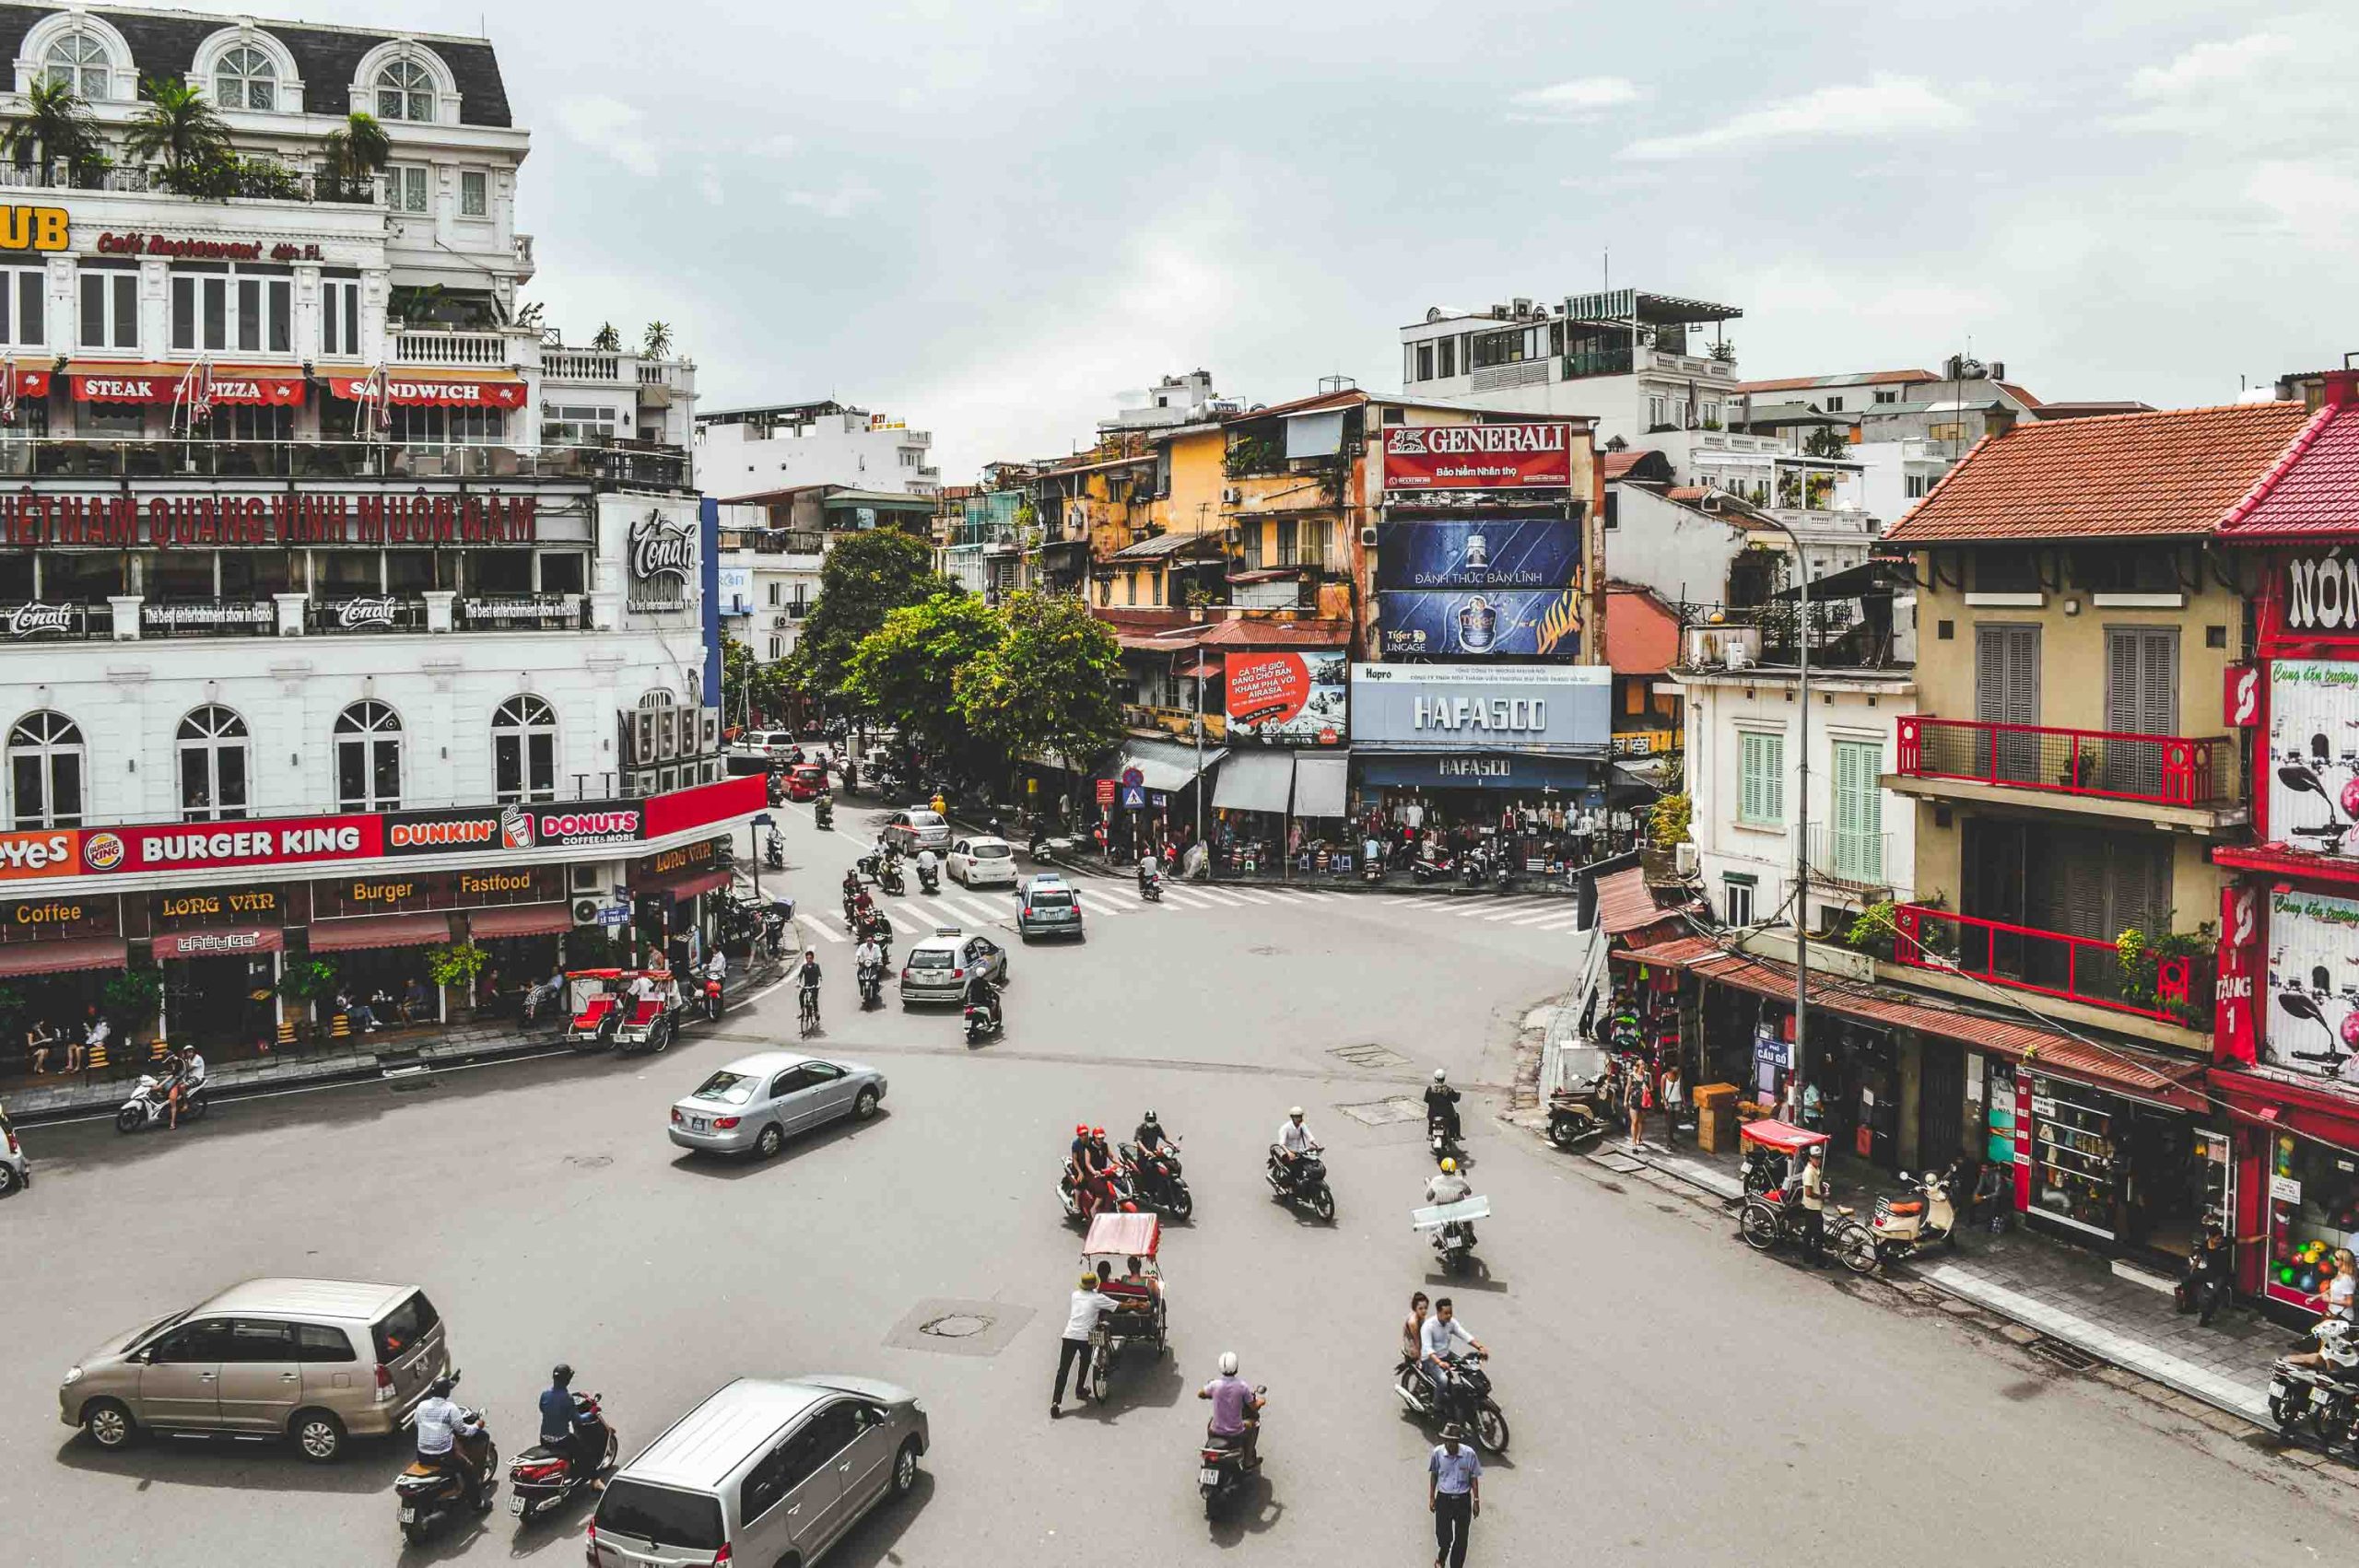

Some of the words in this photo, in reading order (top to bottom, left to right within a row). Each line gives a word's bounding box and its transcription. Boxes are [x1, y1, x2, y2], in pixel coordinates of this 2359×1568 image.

[86, 380, 153, 397] STEAK
[1428, 426, 1565, 453] GENERALI
[59, 497, 137, 545] NAM
[149, 497, 264, 550] QUANG
[271, 495, 346, 542] VINH
[461, 488, 537, 542] NĂM
[145, 608, 158, 623] The
[159, 608, 175, 623] best
[1387, 631, 1412, 643] Tiger
[1366, 668, 1392, 680] Hapro
[1249, 685, 1283, 699] AIRASIA
[1414, 696, 1546, 731] HAFASCO
[1439, 759, 1510, 776] HAFASCO
[392, 819, 497, 846] DUNKIN'
[543, 813, 638, 837] DONUTS
[89, 839, 119, 854] BURGER
[143, 833, 273, 861] BURGER
[282, 827, 359, 854] KING
[91, 846, 120, 863] KING
[354, 883, 414, 902] Burger
[462, 872, 530, 893] Fastfood
[17, 906, 82, 924] Coffee
